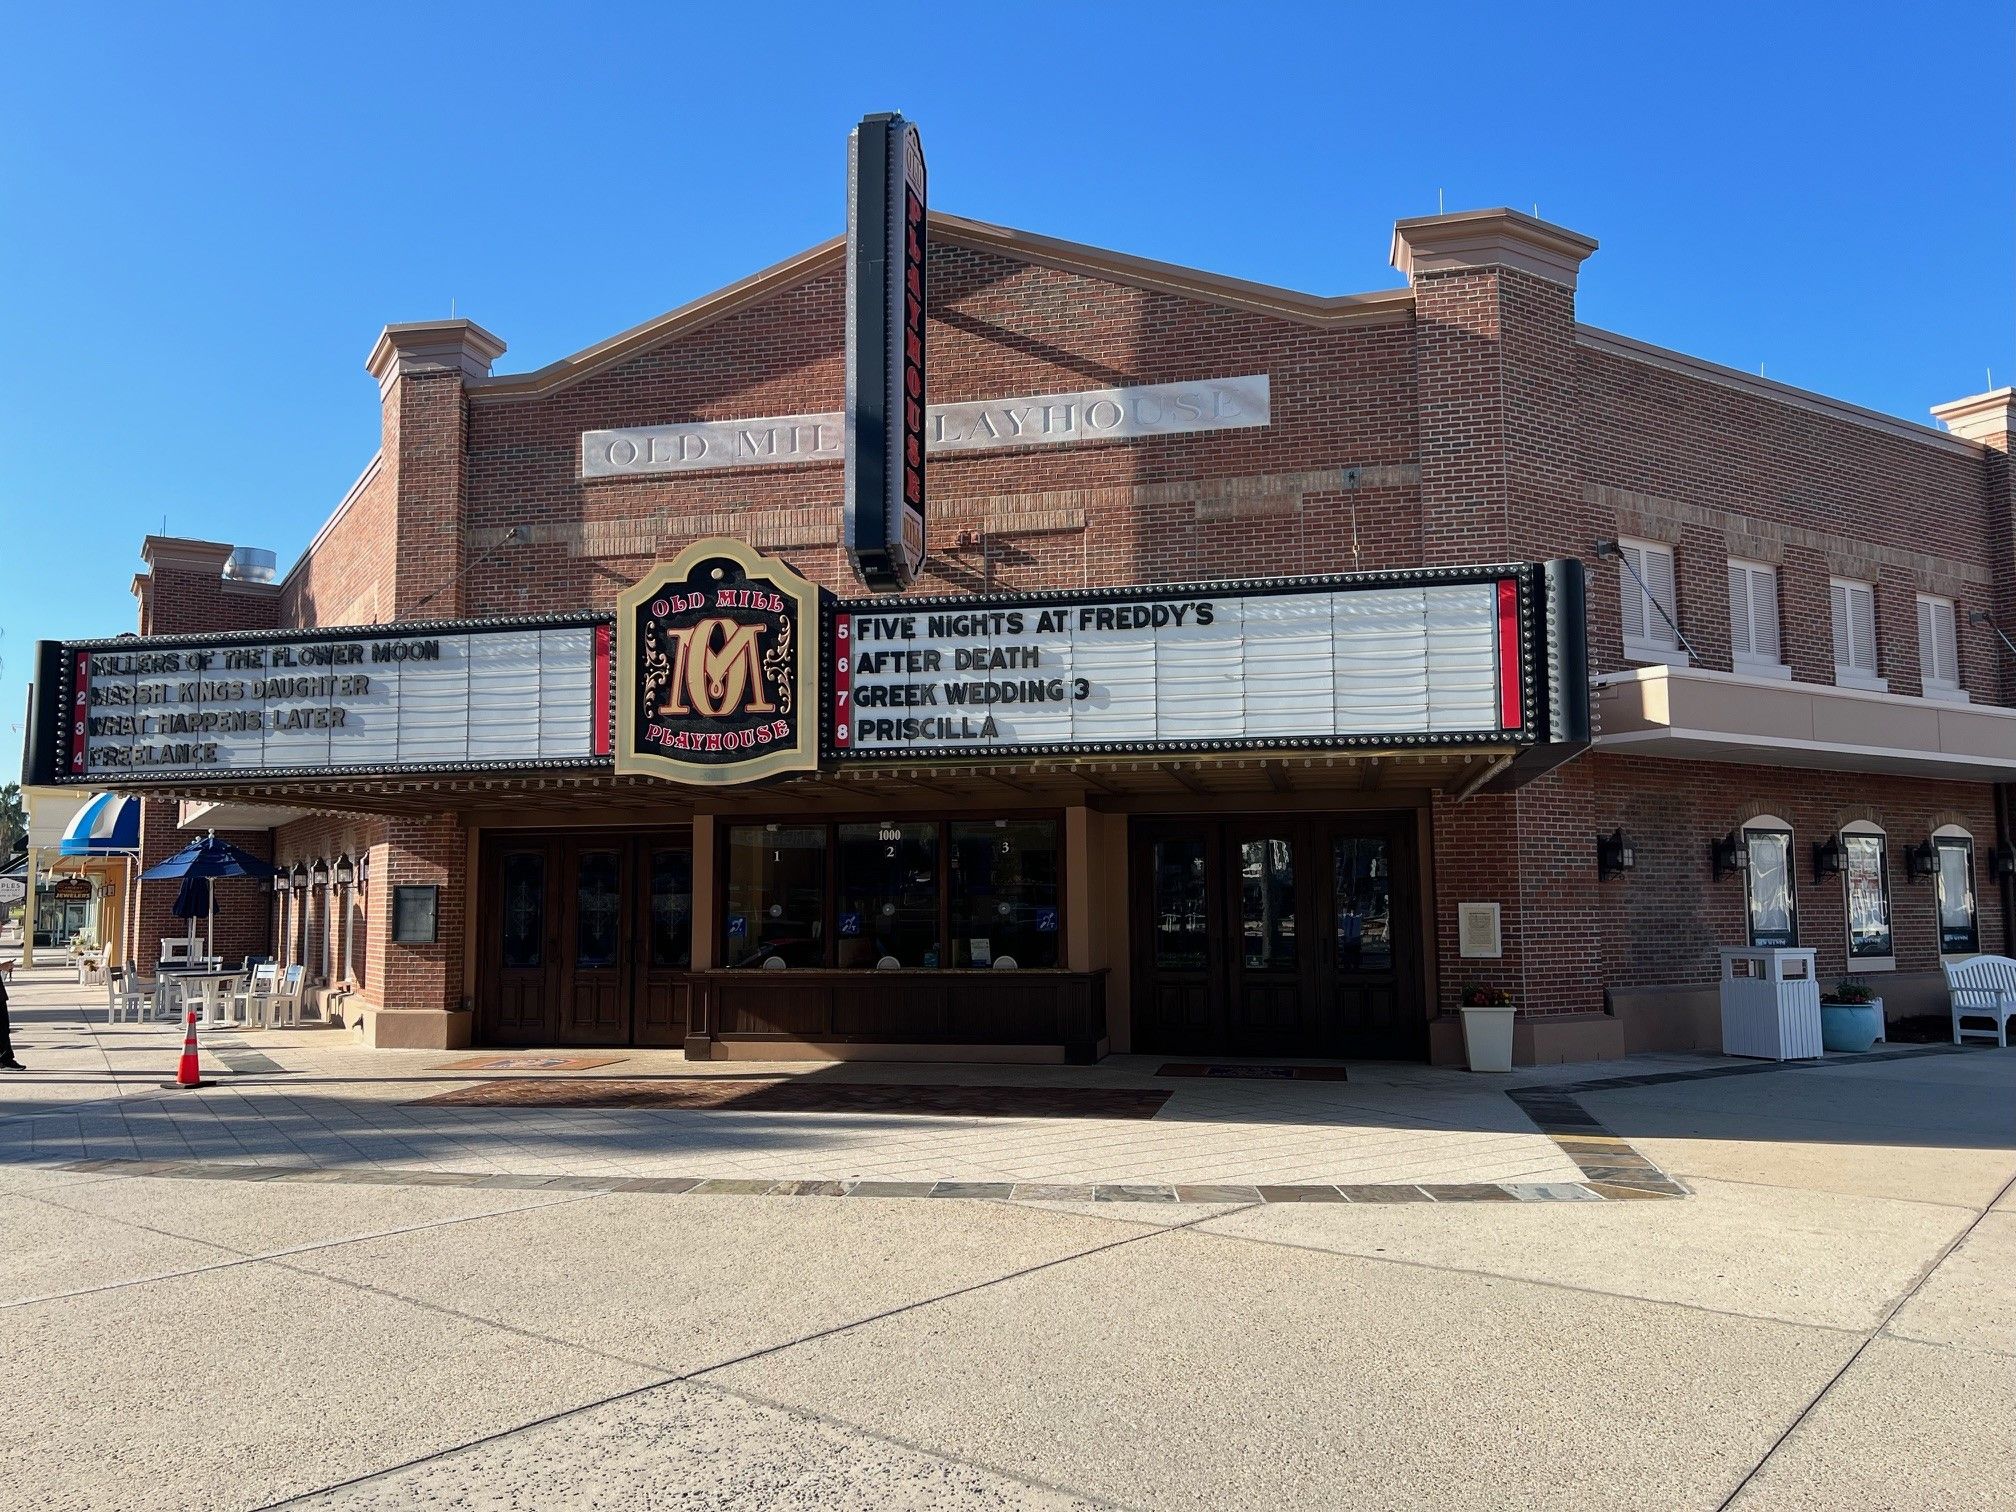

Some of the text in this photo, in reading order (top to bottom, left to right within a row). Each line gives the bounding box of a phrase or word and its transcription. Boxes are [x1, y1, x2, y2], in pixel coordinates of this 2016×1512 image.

[906, 190, 923, 504] PLAYHOUSE
[925, 390, 1242, 443] LAYHOUSE
[604, 424, 840, 466] OLD MIL
[652, 589, 785, 618] OLD MILL
[837, 602, 1214, 641] 5 FIVE NIGHTS AT FREDDY'S
[79, 640, 440, 677] 1 KILLERS OF THE FLOWER MOON
[837, 646, 1039, 675] 6 AFTER DEATH
[76, 691, 86, 706] 2
[179, 680, 244, 701] KINGS
[251, 674, 370, 700] DAUGHTER
[837, 677, 1090, 708] 7 GREEK WEDDING 3
[74, 706, 346, 737] 3 WHAT HAPPENS LATER
[645, 719, 790, 751] PLAYHOUSE
[837, 715, 999, 742] 8 PRISCILLA
[73, 742, 218, 767] 4 FREELANCE
[878, 829, 901, 842] 1000
[1001, 842, 1010, 854] 3
[773, 850, 781, 862] 1
[886, 845, 895, 858] 2
